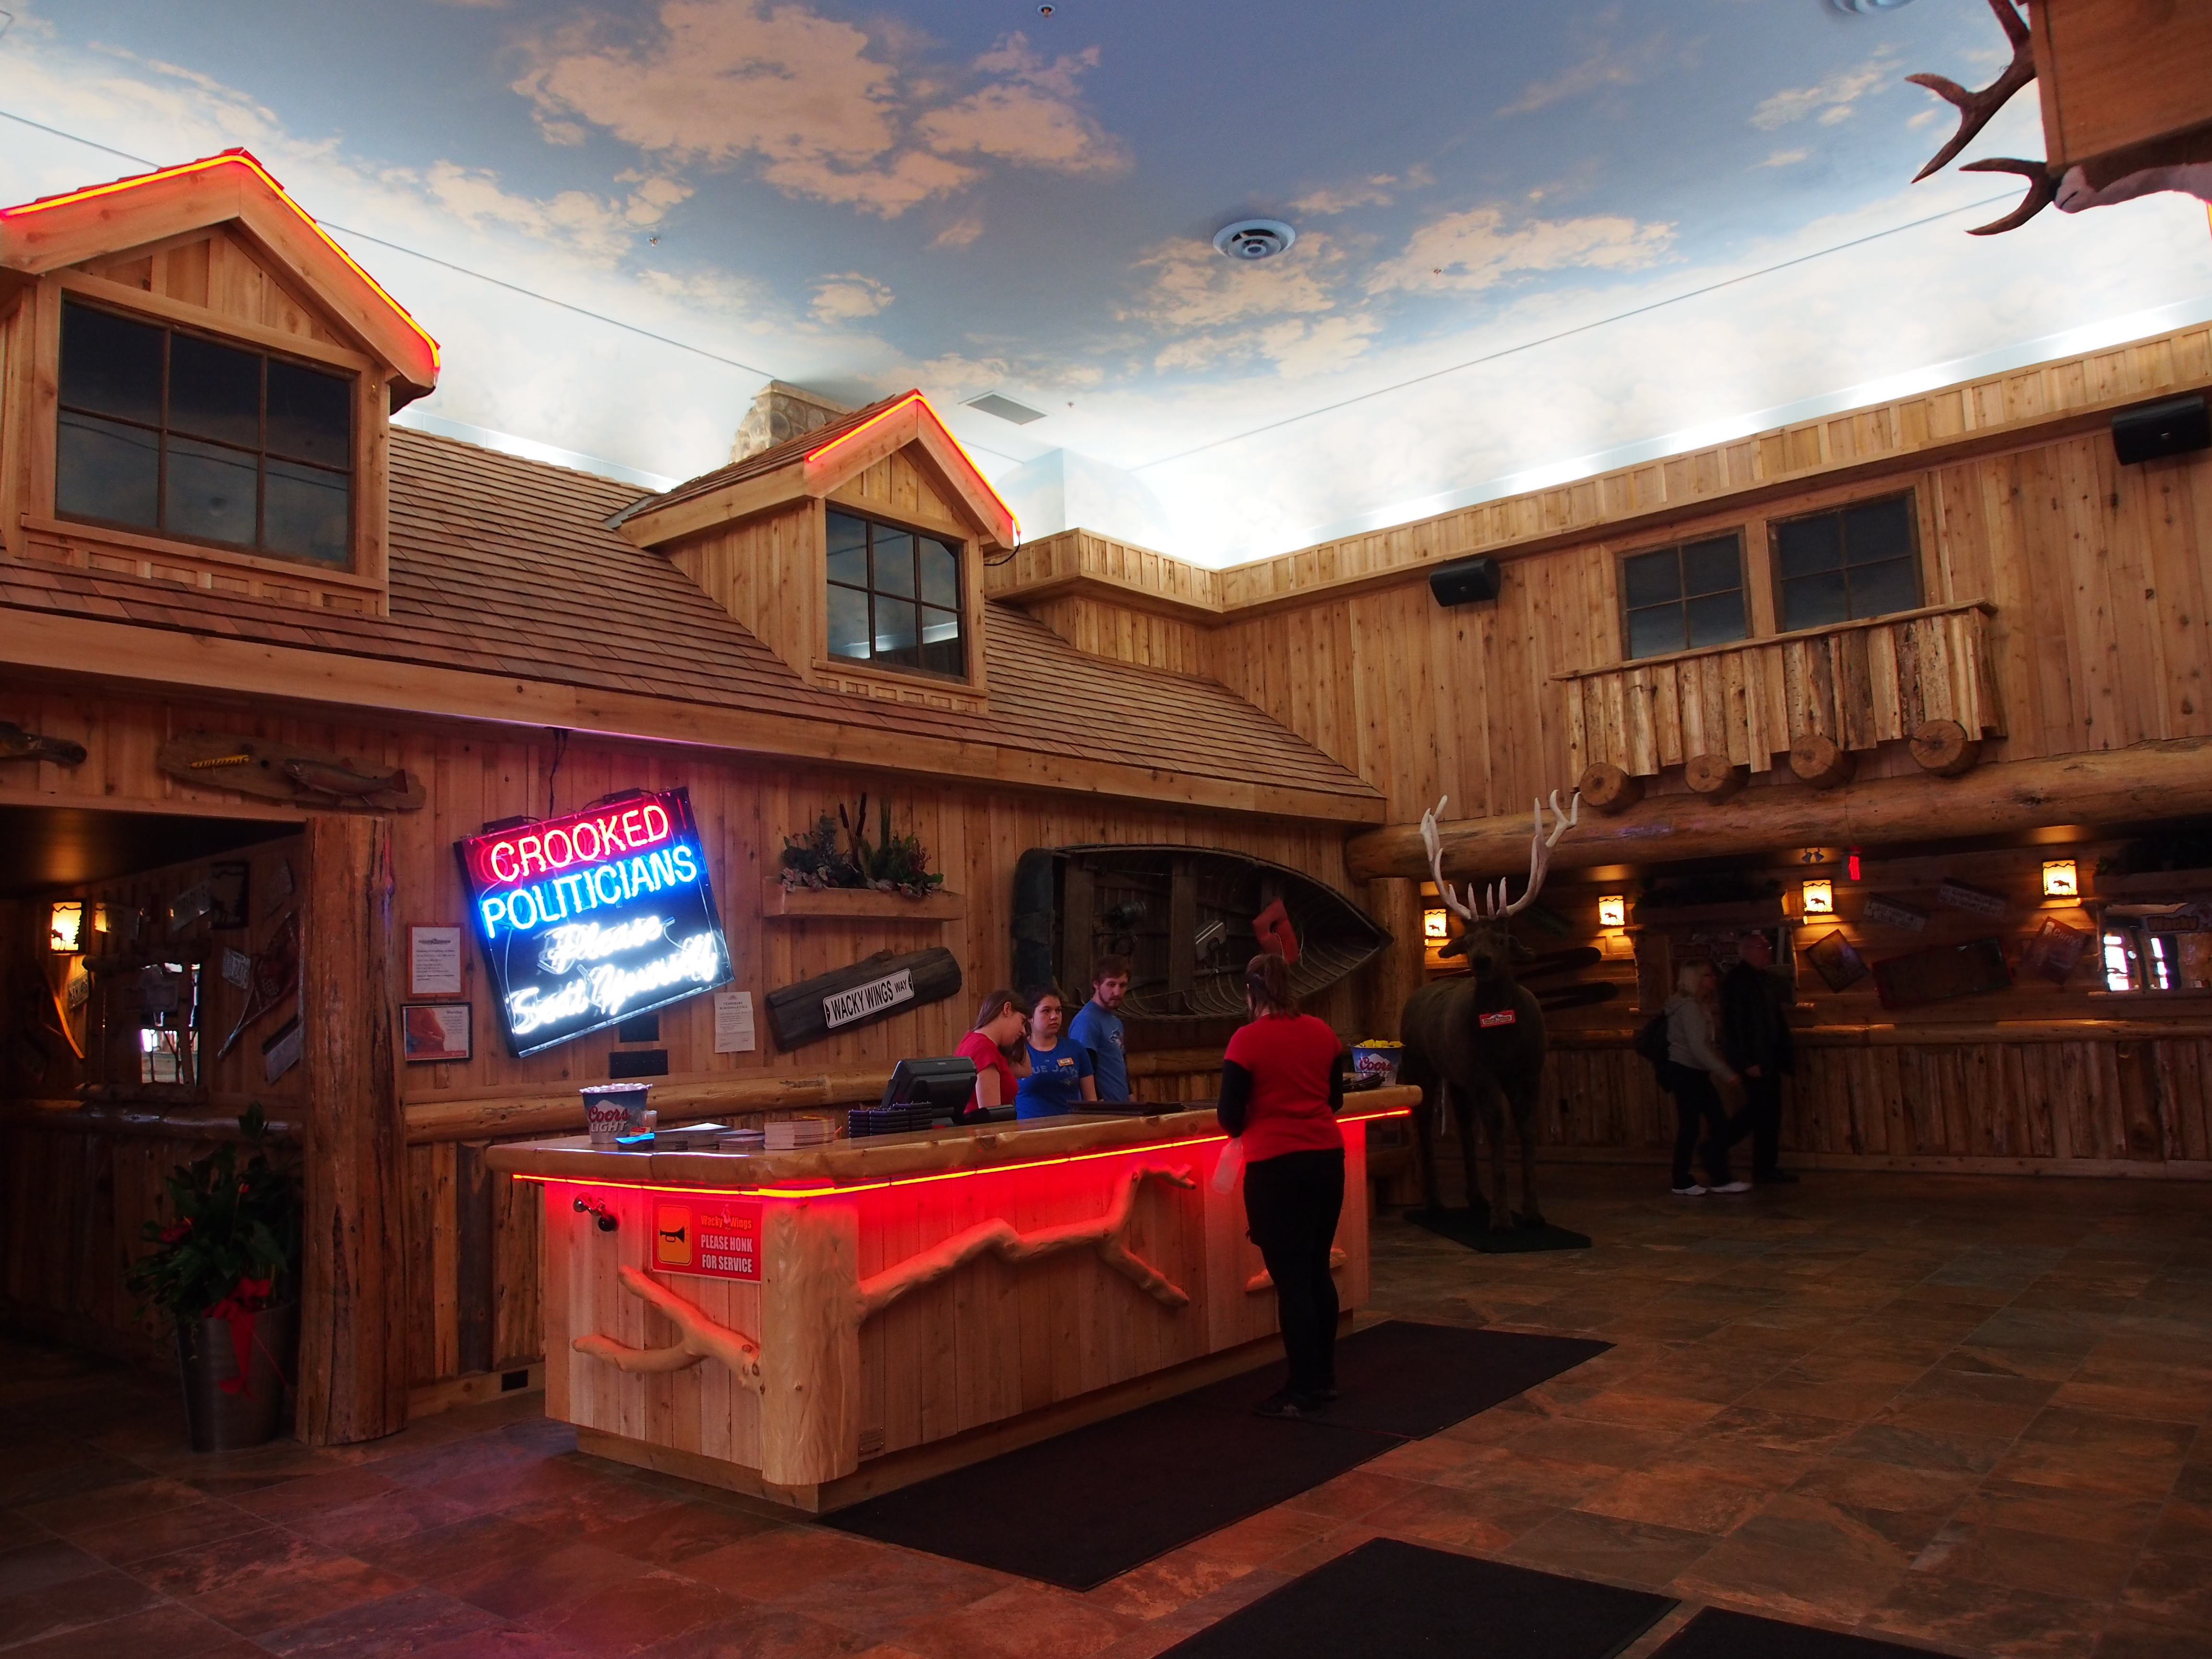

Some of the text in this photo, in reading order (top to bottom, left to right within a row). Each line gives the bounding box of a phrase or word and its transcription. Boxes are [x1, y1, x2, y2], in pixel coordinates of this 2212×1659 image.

[491, 804, 669, 882] CROOKED
[482, 844, 697, 939] POLITICIANS
[547, 915, 663, 974] Please
[512, 932, 718, 1034] Seat Yourself
[831, 979, 907, 1021] WACKY WINGS WAY
[1359, 1057, 1393, 1071] Coors
[588, 1106, 628, 1123] Coors
[591, 1121, 627, 1133] LIGHT
[700, 1214, 752, 1230] Wacky Wings
[700, 1234, 753, 1252] PLEASE HONK
[702, 1254, 752, 1273] FOR SERVICE
